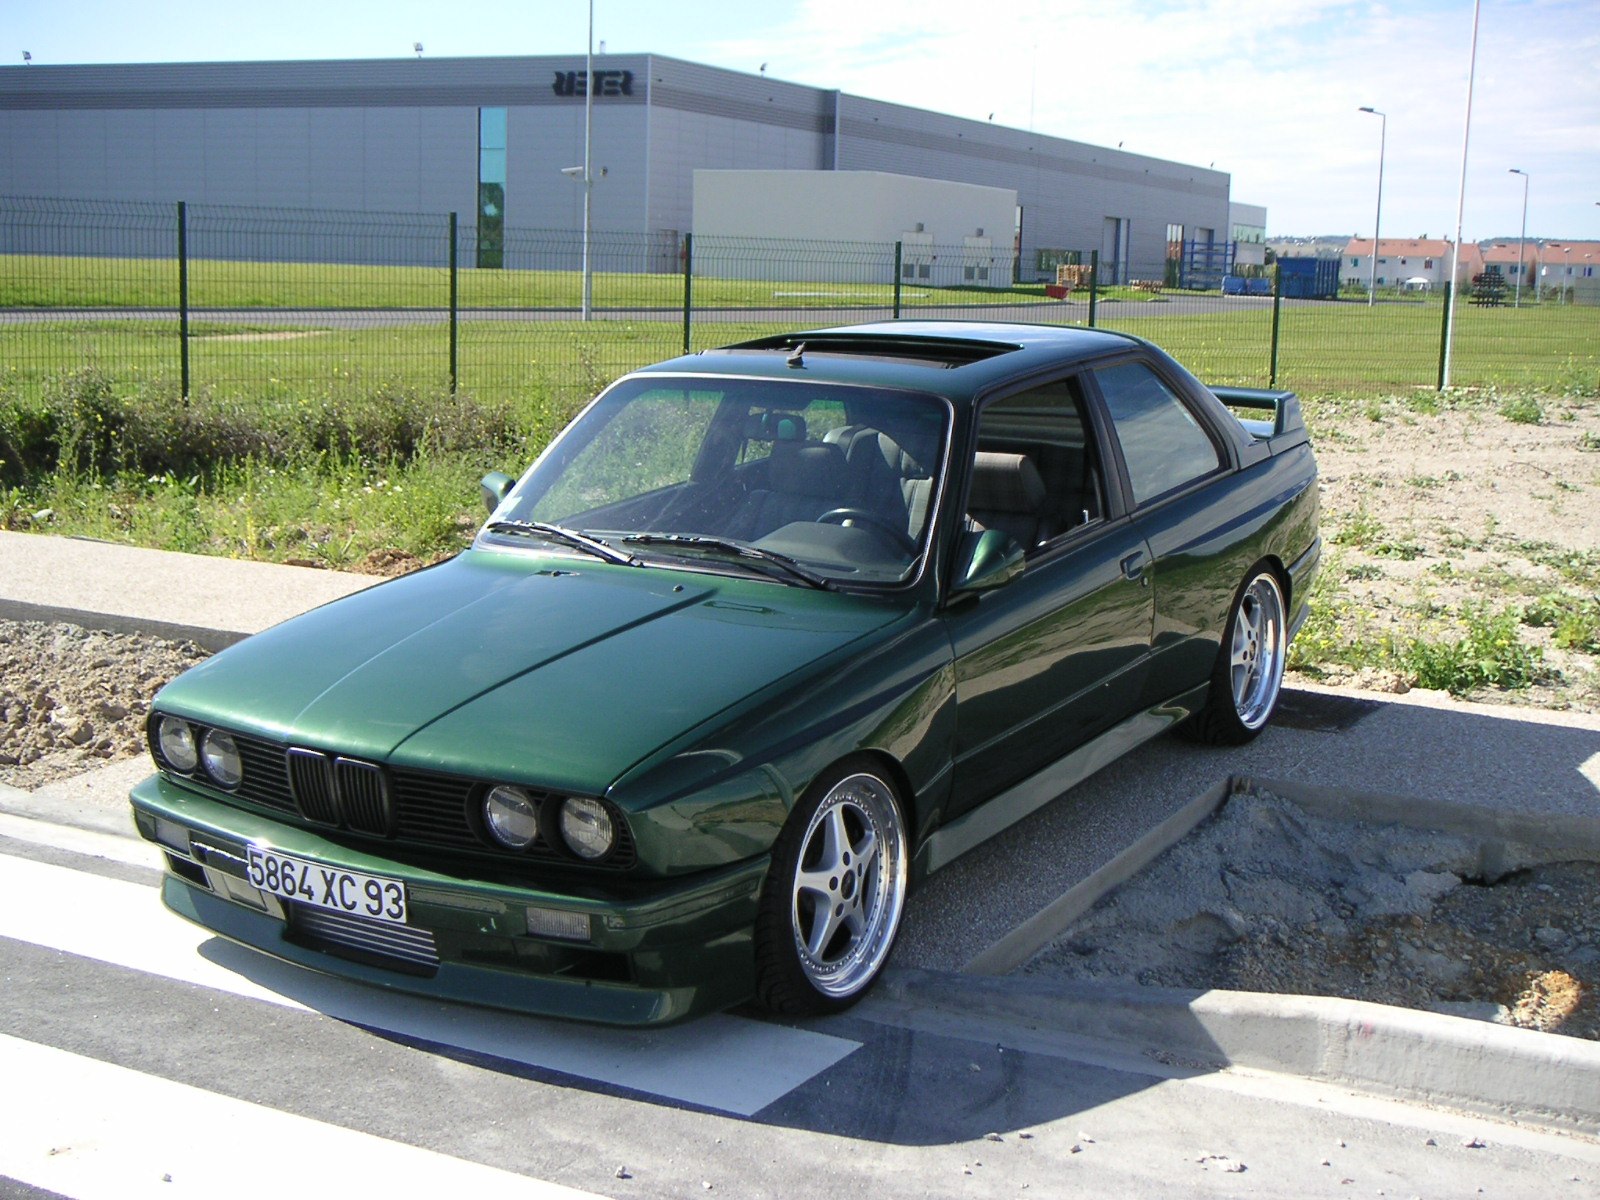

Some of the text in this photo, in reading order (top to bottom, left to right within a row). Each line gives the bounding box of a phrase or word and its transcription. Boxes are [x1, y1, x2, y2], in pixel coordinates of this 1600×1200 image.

[250, 852, 404, 919] 5864 XC 93
